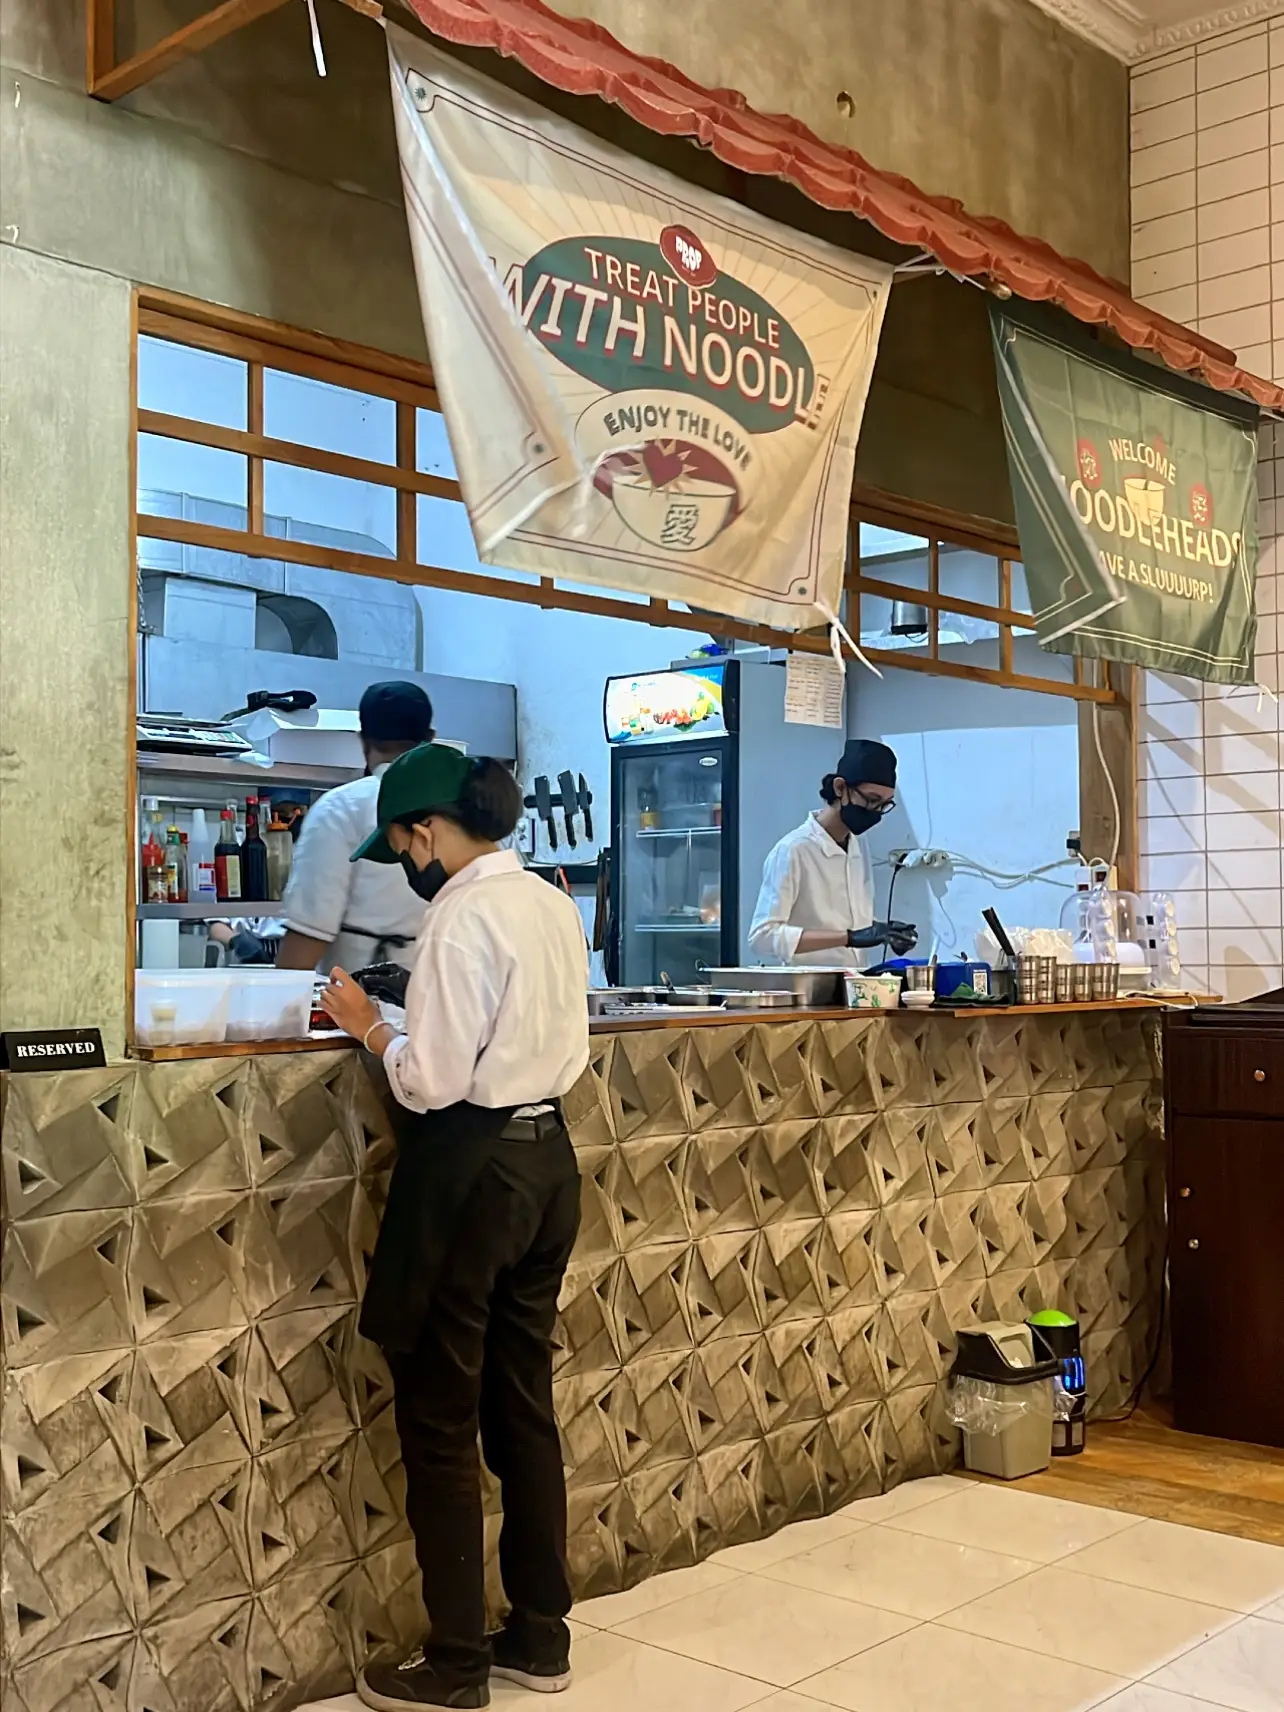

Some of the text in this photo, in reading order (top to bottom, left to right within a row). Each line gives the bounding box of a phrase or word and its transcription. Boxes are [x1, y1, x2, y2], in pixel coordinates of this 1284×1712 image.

[584, 247, 780, 349] TREAT PEOPLE
[488, 254, 831, 430] WITH NOODLE
[603, 404, 752, 472] ENJOY THE LOVE
[1108, 437, 1177, 486] WELCOME
[1060, 475, 1242, 569] OODLEHEADS
[1098, 549, 1214, 604] AVE A SLUUUURP!
[17, 1041, 96, 1058] RESERVED
